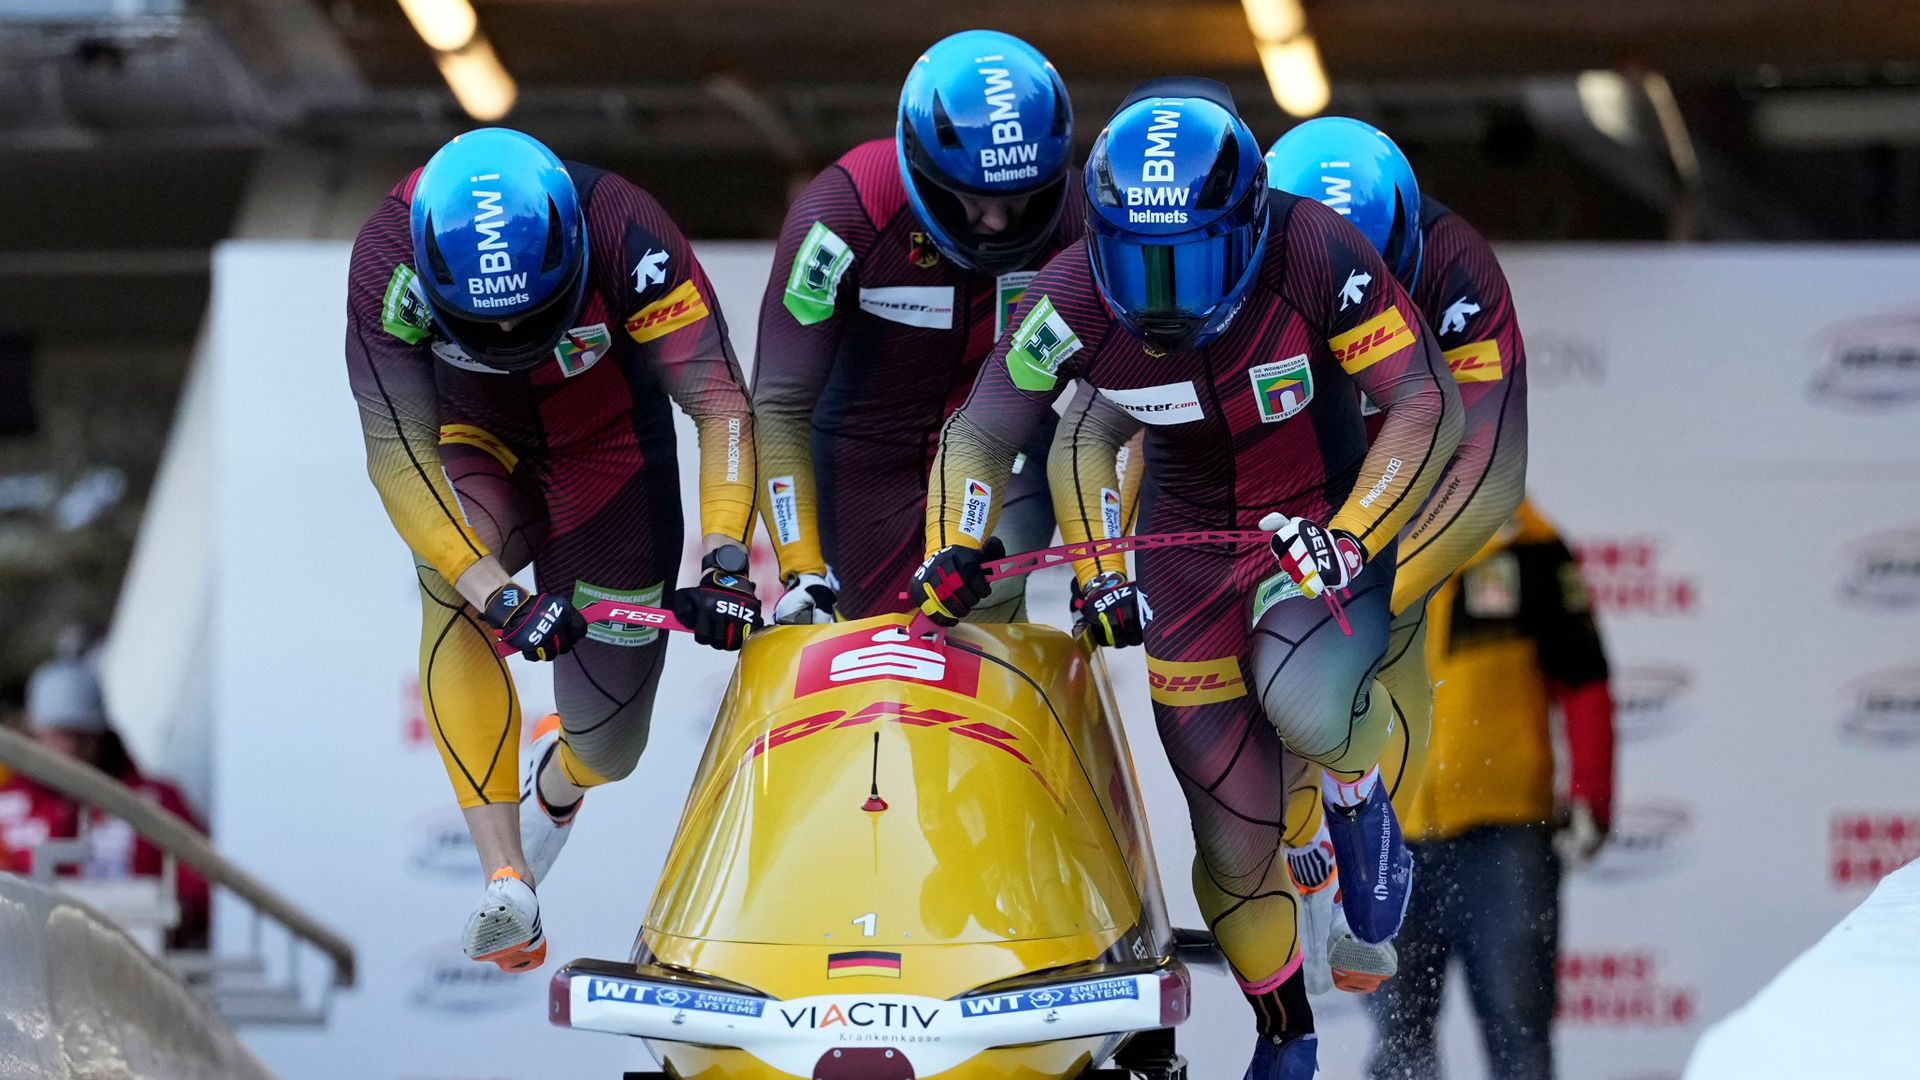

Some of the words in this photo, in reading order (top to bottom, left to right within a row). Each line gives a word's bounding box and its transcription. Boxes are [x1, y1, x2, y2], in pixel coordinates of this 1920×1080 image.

[975, 54, 1004, 64] i
[978, 68, 1023, 145] BMW
[980, 143, 1038, 168] BMW
[1142, 106, 1183, 182] BMW
[471, 173, 500, 183] i
[983, 164, 1038, 183] helmets
[1127, 187, 1190, 207] BMW
[1128, 209, 1188, 224] helmets
[472, 190, 511, 274] BMW
[468, 272, 527, 295] BMW
[472, 292, 530, 308] helmets
[628, 299, 691, 332] DHL
[1411, 476, 1461, 540] Bundeswehr
[1306, 526, 1331, 572] SEIZ
[1094, 587, 1132, 612] SEIZ
[609, 608, 666, 624] FES
[716, 600, 754, 623] SEIZ
[528, 602, 563, 646] SEIZ
[1148, 669, 1227, 692] DHL
[741, 701, 1033, 768] DHL
[852, 913, 877, 937] 1
[595, 980, 653, 1001] WT
[1070, 985, 1135, 1001] SYSTEME
[1071, 978, 1130, 993] ENERGIE
[694, 1000, 759, 1015] SYSTEME
[698, 993, 758, 1007] ENERGIE
[966, 994, 1024, 1014] WT
[780, 1002, 940, 1028] VIACTIV
[840, 1032, 941, 1043] Krankenkasse
